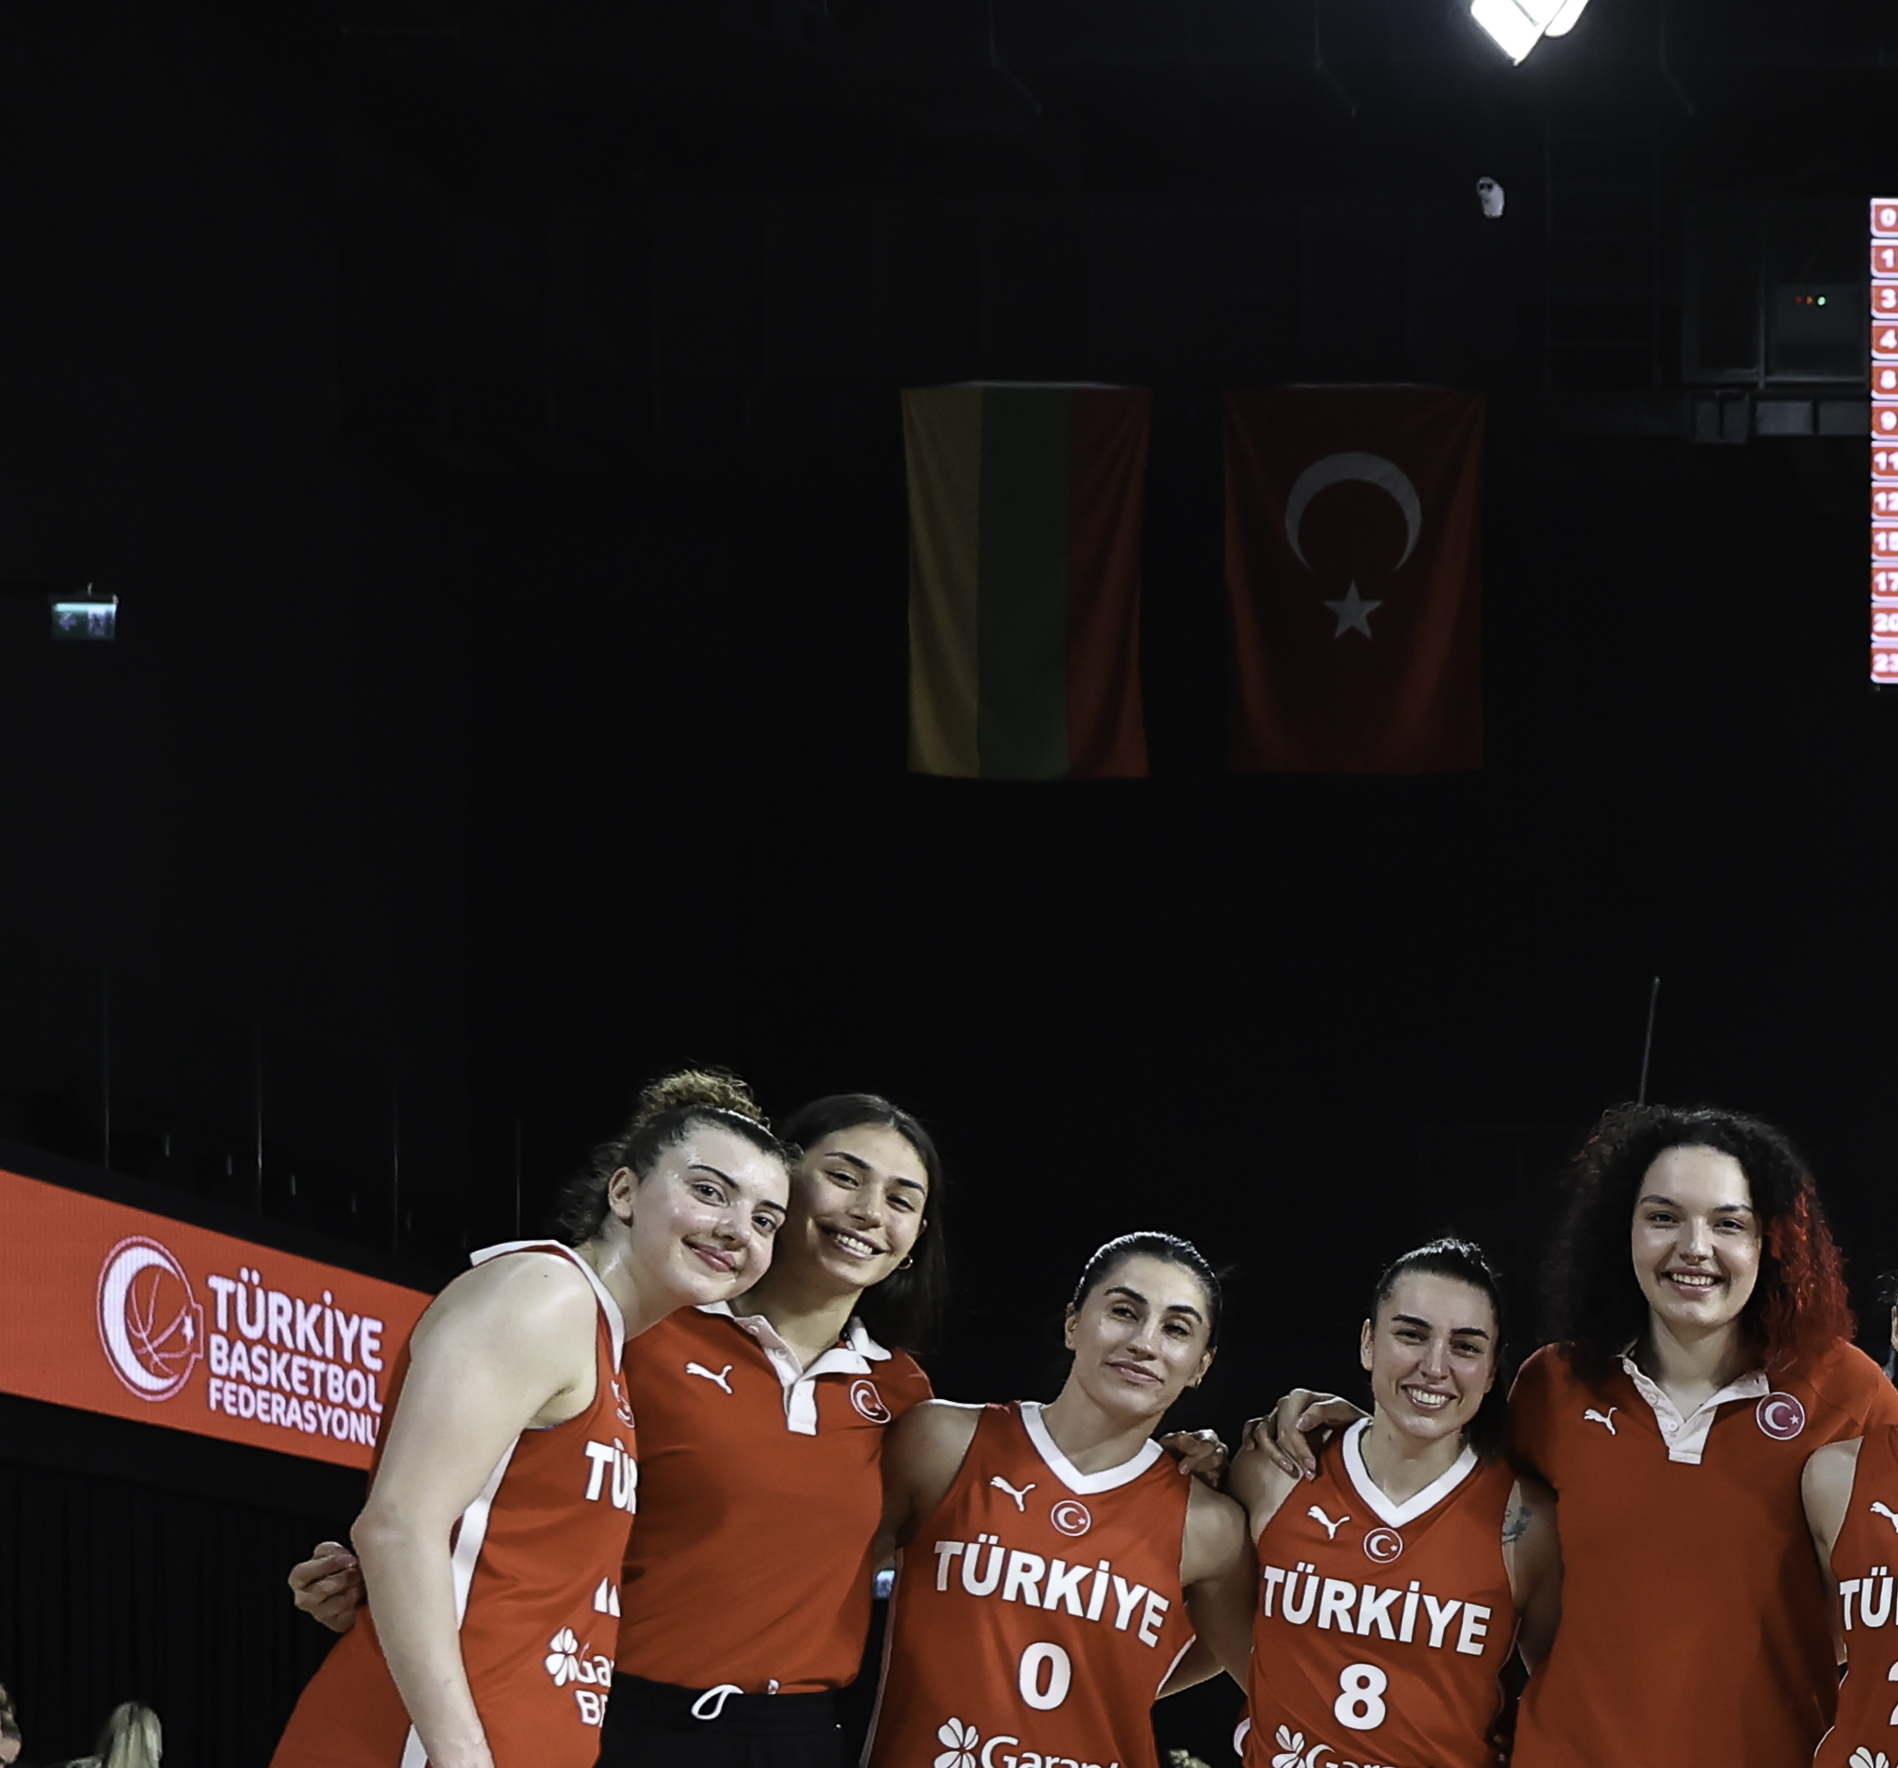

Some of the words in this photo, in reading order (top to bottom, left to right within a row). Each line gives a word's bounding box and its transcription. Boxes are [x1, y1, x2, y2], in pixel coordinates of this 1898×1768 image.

[1880, 208, 1897, 227] 0
[1882, 249, 1895, 268] 1
[1881, 289, 1897, 308] 3
[1880, 329, 1897, 348] 4
[207, 1267, 383, 1372] TÜRKİYE
[209, 1334, 383, 1413] BASKETBOL
[936, 1534, 1169, 1647] TÜRKİYE
[1264, 1562, 1491, 1655] TÜRKİYE
[1019, 1642, 1071, 1710] 0
[1334, 1664, 1387, 1730] 8
